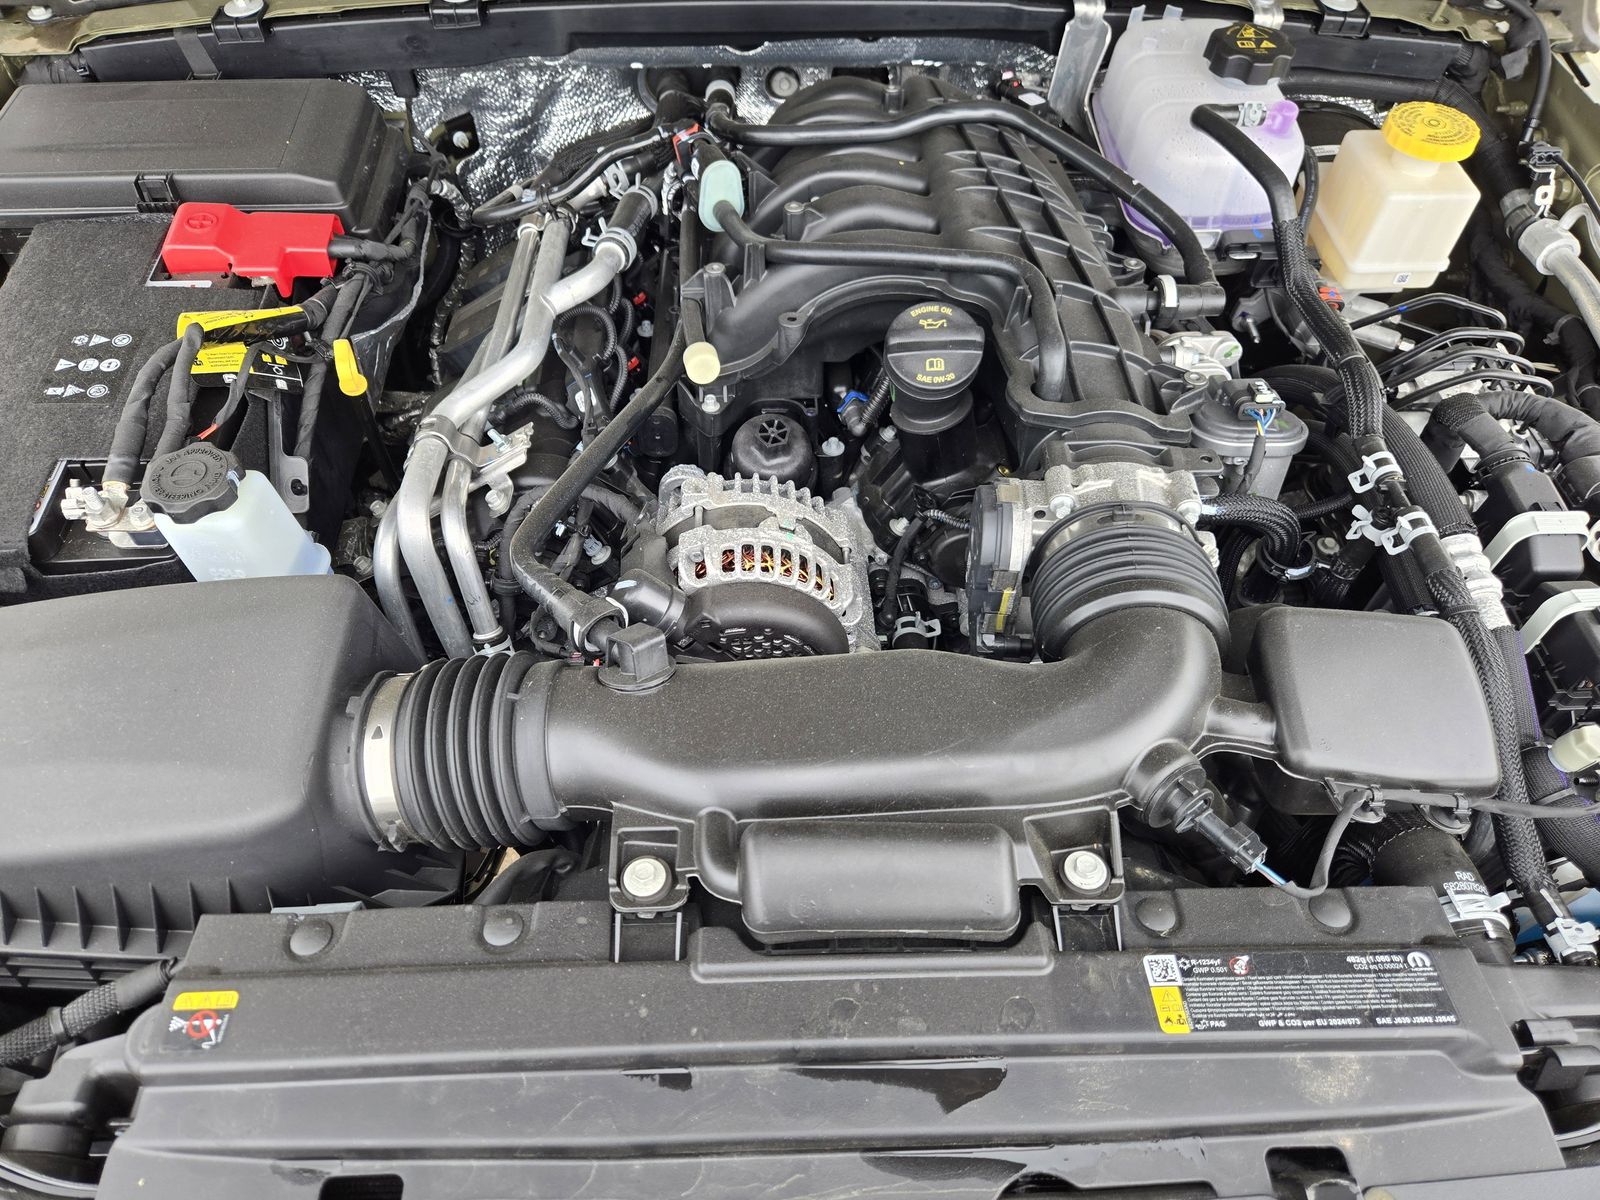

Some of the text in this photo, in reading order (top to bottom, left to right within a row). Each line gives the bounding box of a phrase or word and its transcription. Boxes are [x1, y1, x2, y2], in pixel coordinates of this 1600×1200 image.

[910, 305, 953, 318] ENGINE OIL
[916, 372, 956, 384] SAE 0W-20
[1454, 871, 1475, 881] RAD
[1190, 958, 1222, 966] R-1234yf
[1391, 954, 1403, 963] lb)
[1210, 966, 1228, 974] 0.501
[1210, 1020, 1227, 1028] PAG
[1258, 1019, 1277, 1027] GWP
[1285, 1019, 1301, 1027] CO2
[1303, 1019, 1315, 1028] per
[1315, 1018, 1328, 1026] EU
[1376, 1017, 1393, 1025] SAE
